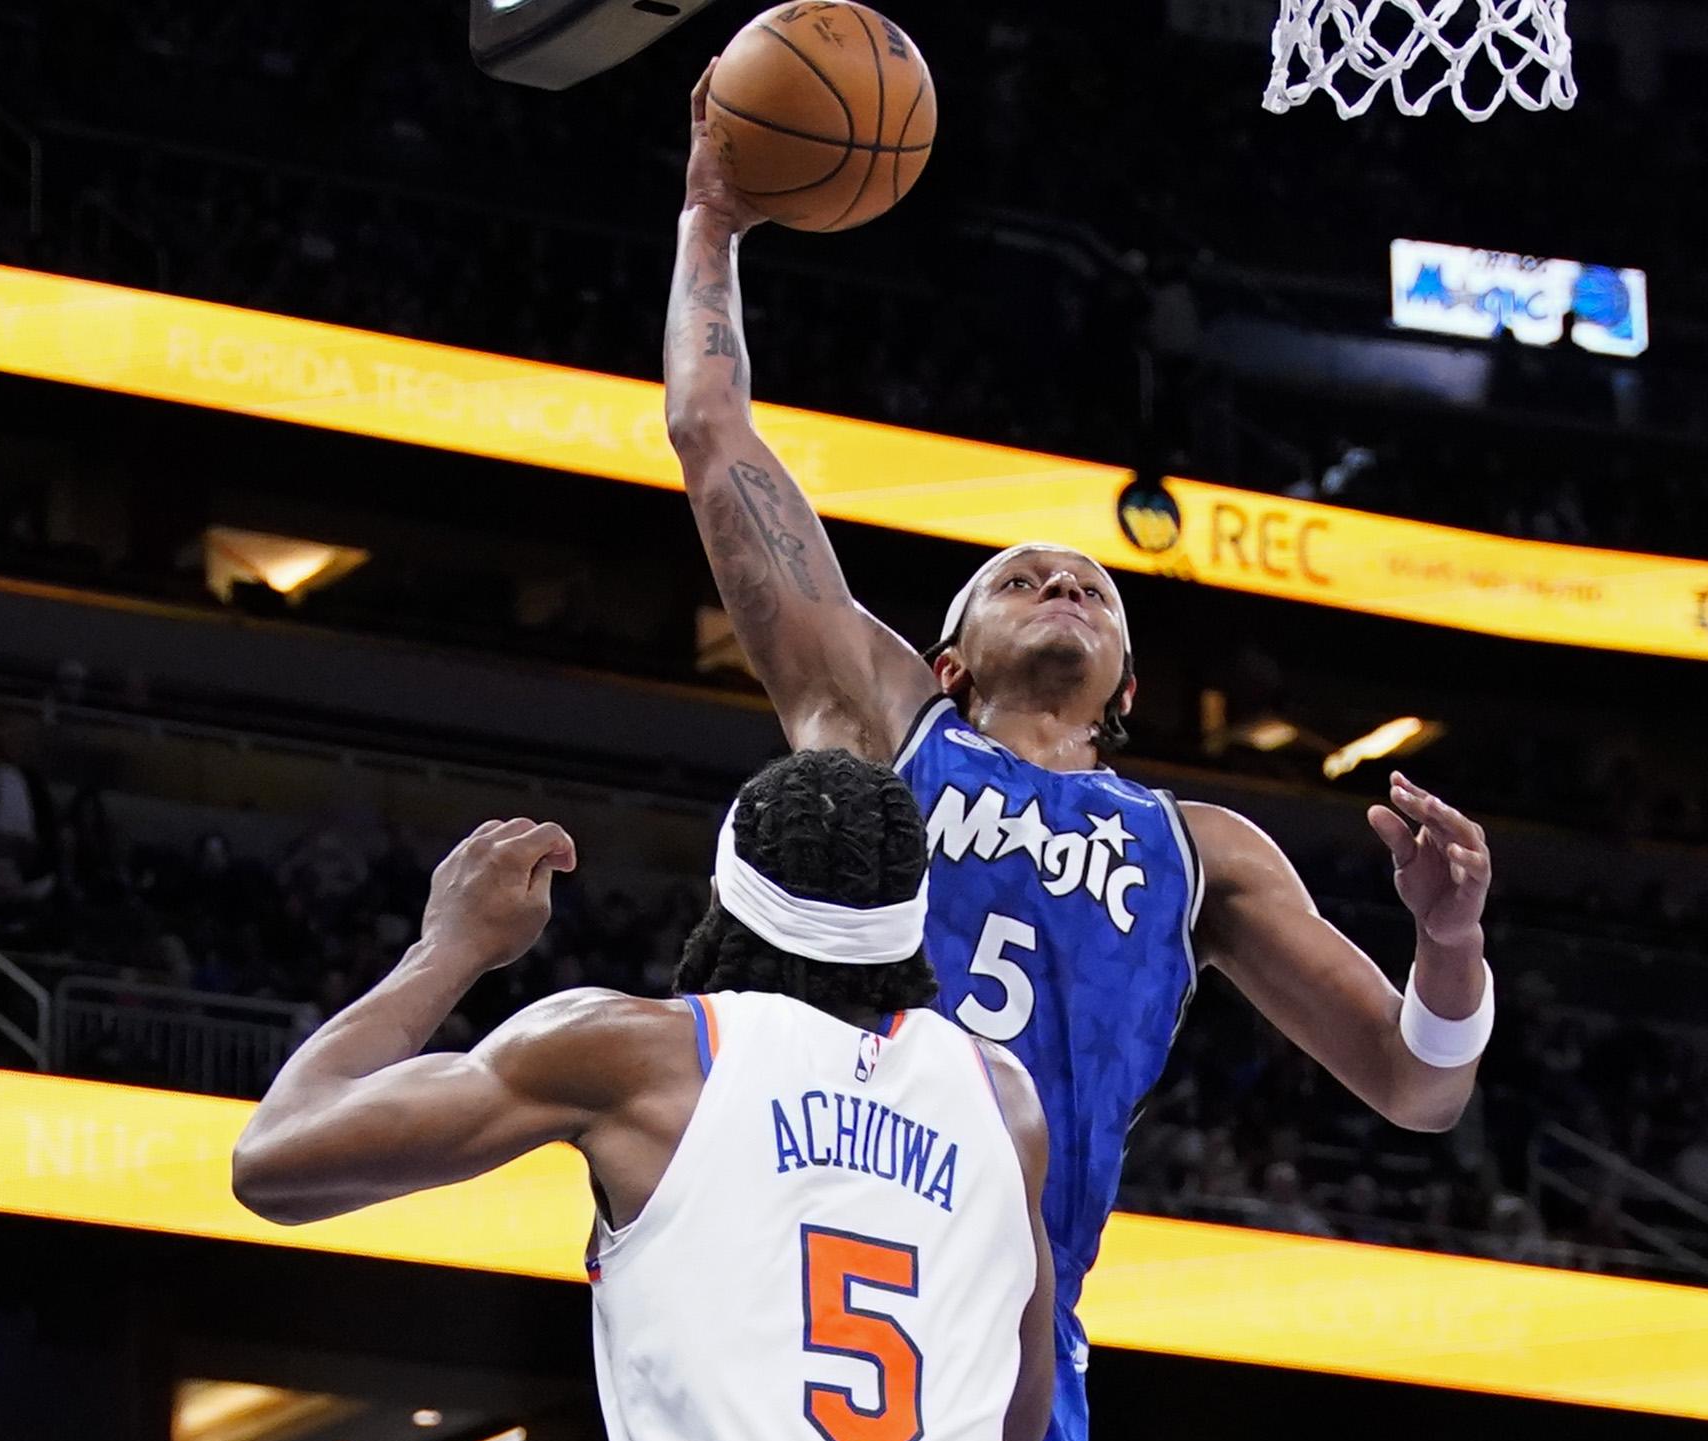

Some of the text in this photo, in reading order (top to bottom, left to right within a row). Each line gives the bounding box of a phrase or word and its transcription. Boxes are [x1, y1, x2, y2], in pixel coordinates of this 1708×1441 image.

[1210, 504, 1334, 588] REC
[925, 784, 1147, 935] Magic
[955, 911, 1037, 1042] 5
[771, 1090, 959, 1213] ACHIUWA
